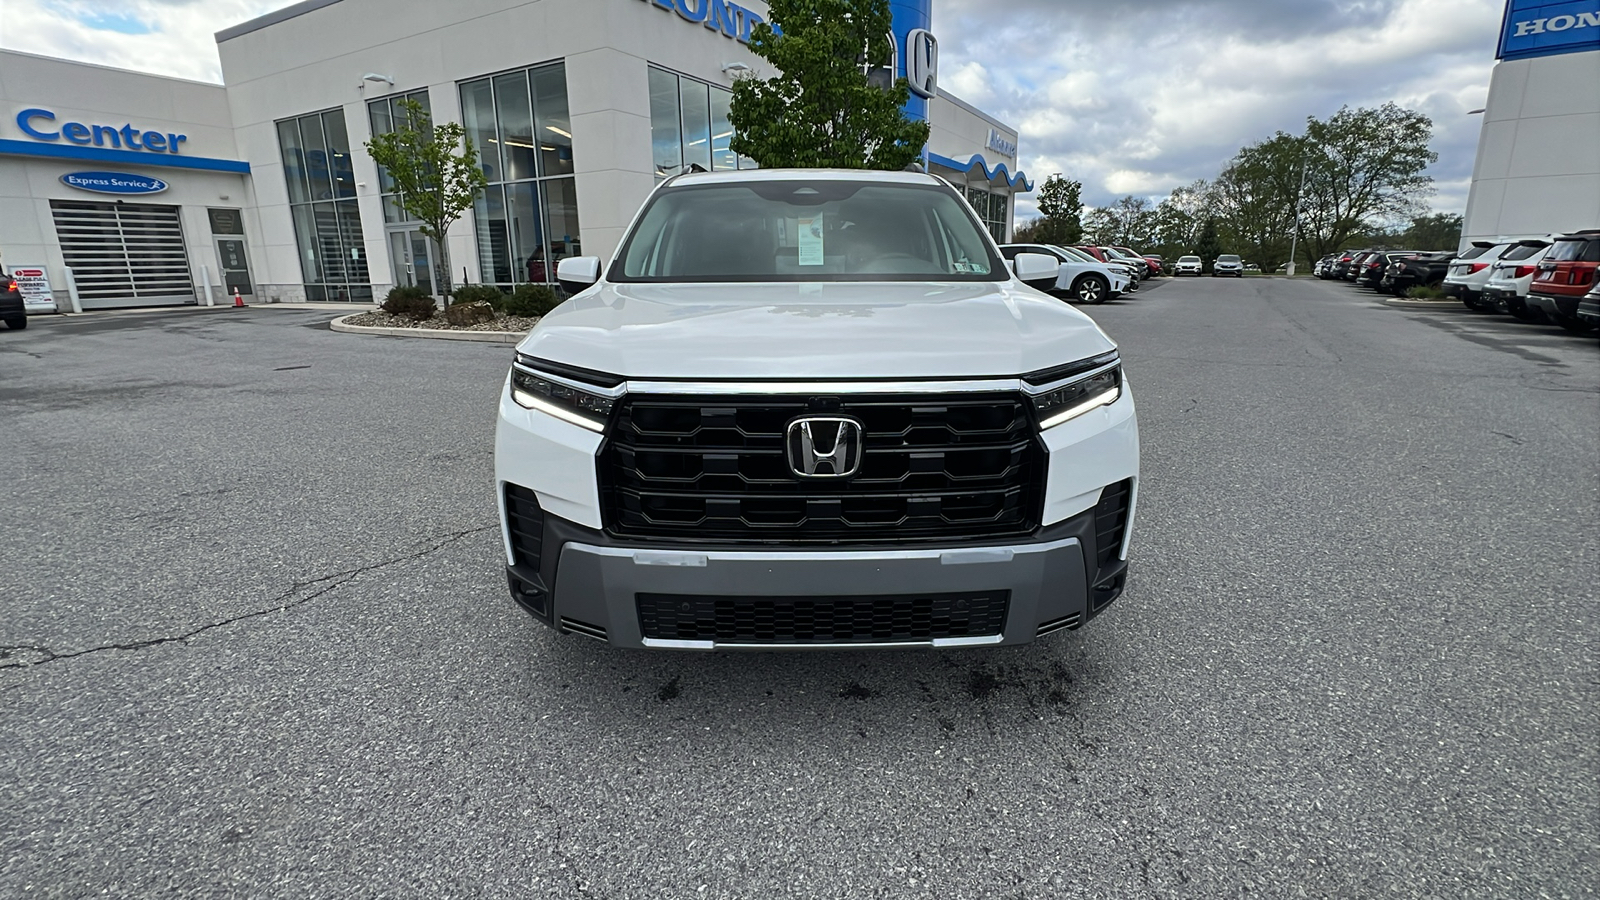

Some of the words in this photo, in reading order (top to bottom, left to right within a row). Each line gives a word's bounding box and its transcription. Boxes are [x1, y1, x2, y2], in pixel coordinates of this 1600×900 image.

[638, 0, 783, 46] OND
[17, 108, 187, 153] Center
[68, 176, 109, 186] Express
[111, 179, 148, 188] Service
